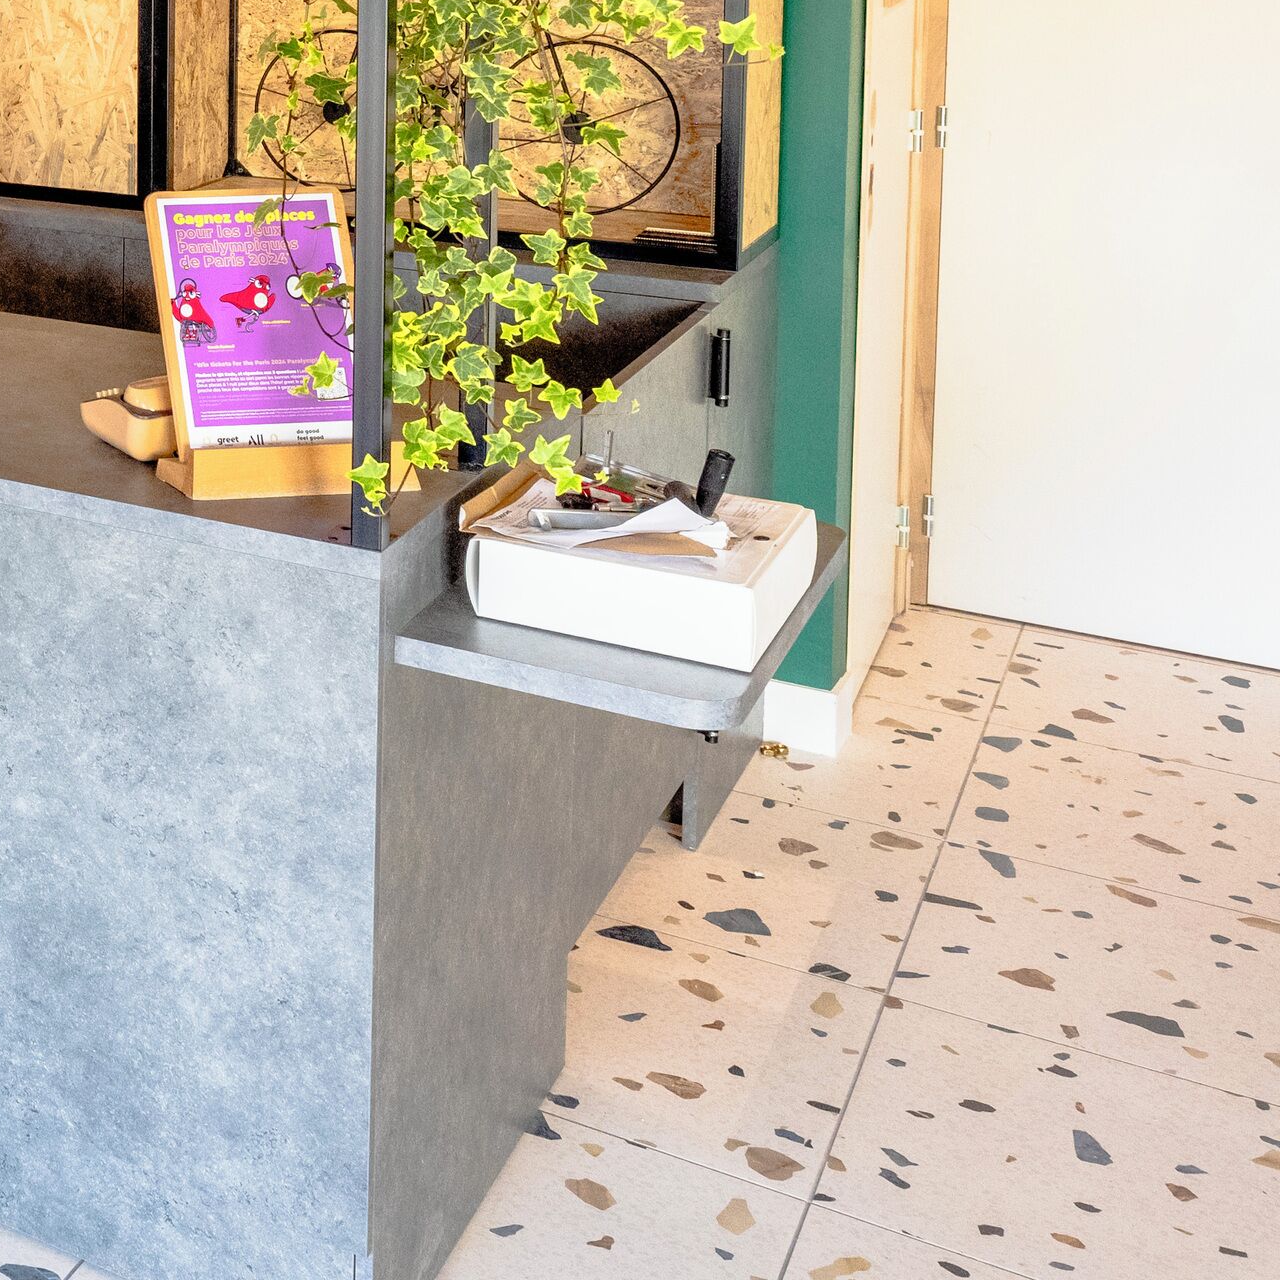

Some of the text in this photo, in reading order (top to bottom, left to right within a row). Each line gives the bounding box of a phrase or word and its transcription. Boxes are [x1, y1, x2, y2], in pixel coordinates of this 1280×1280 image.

[173, 209, 316, 227] Gagnez de places
[176, 225, 282, 242] pour les Jeux
[177, 237, 299, 255] Paralympiques
[180, 255, 200, 269] de
[204, 253, 245, 268] Paris
[287, 357, 318, 365] Paralympi
[217, 435, 239, 446] greet
